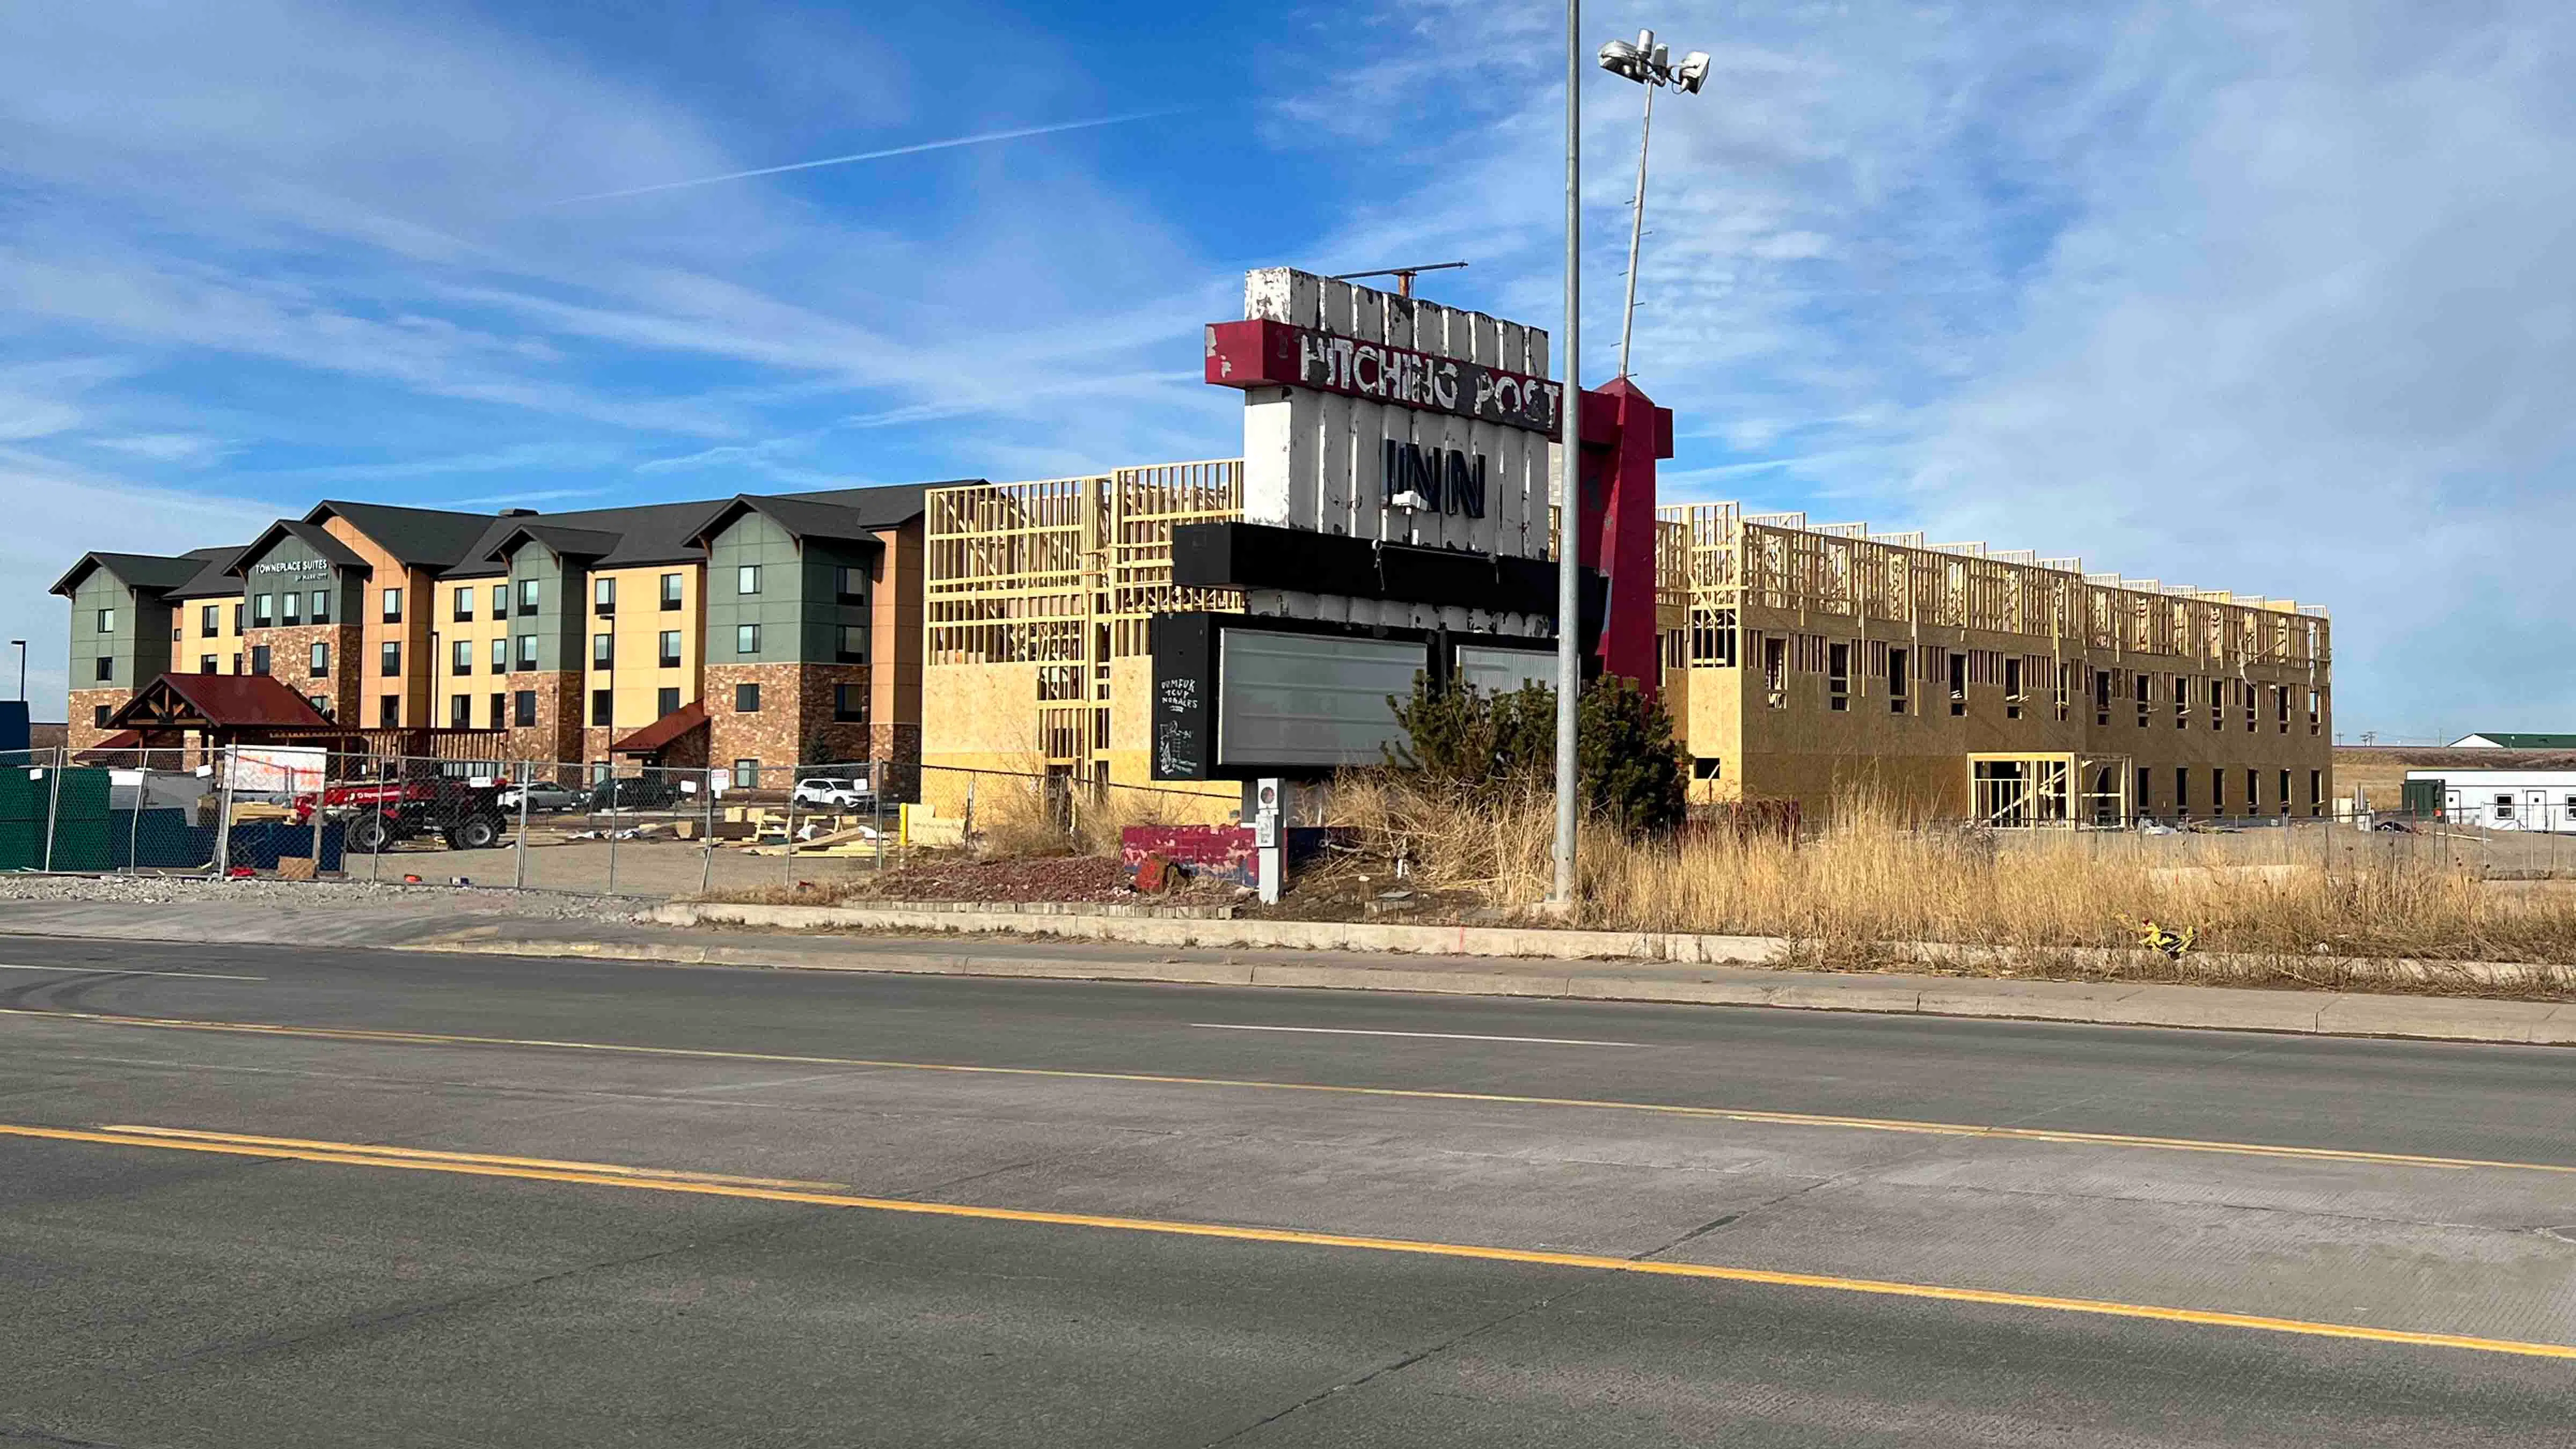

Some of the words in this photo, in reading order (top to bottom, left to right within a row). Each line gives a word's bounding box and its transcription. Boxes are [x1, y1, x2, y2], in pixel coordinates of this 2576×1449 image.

[1300, 334, 1458, 409] HITCHING
[1381, 438, 1486, 519] INN
[255, 561, 301, 574] TOWNEPLACE
[303, 559, 327, 570] SUITES
